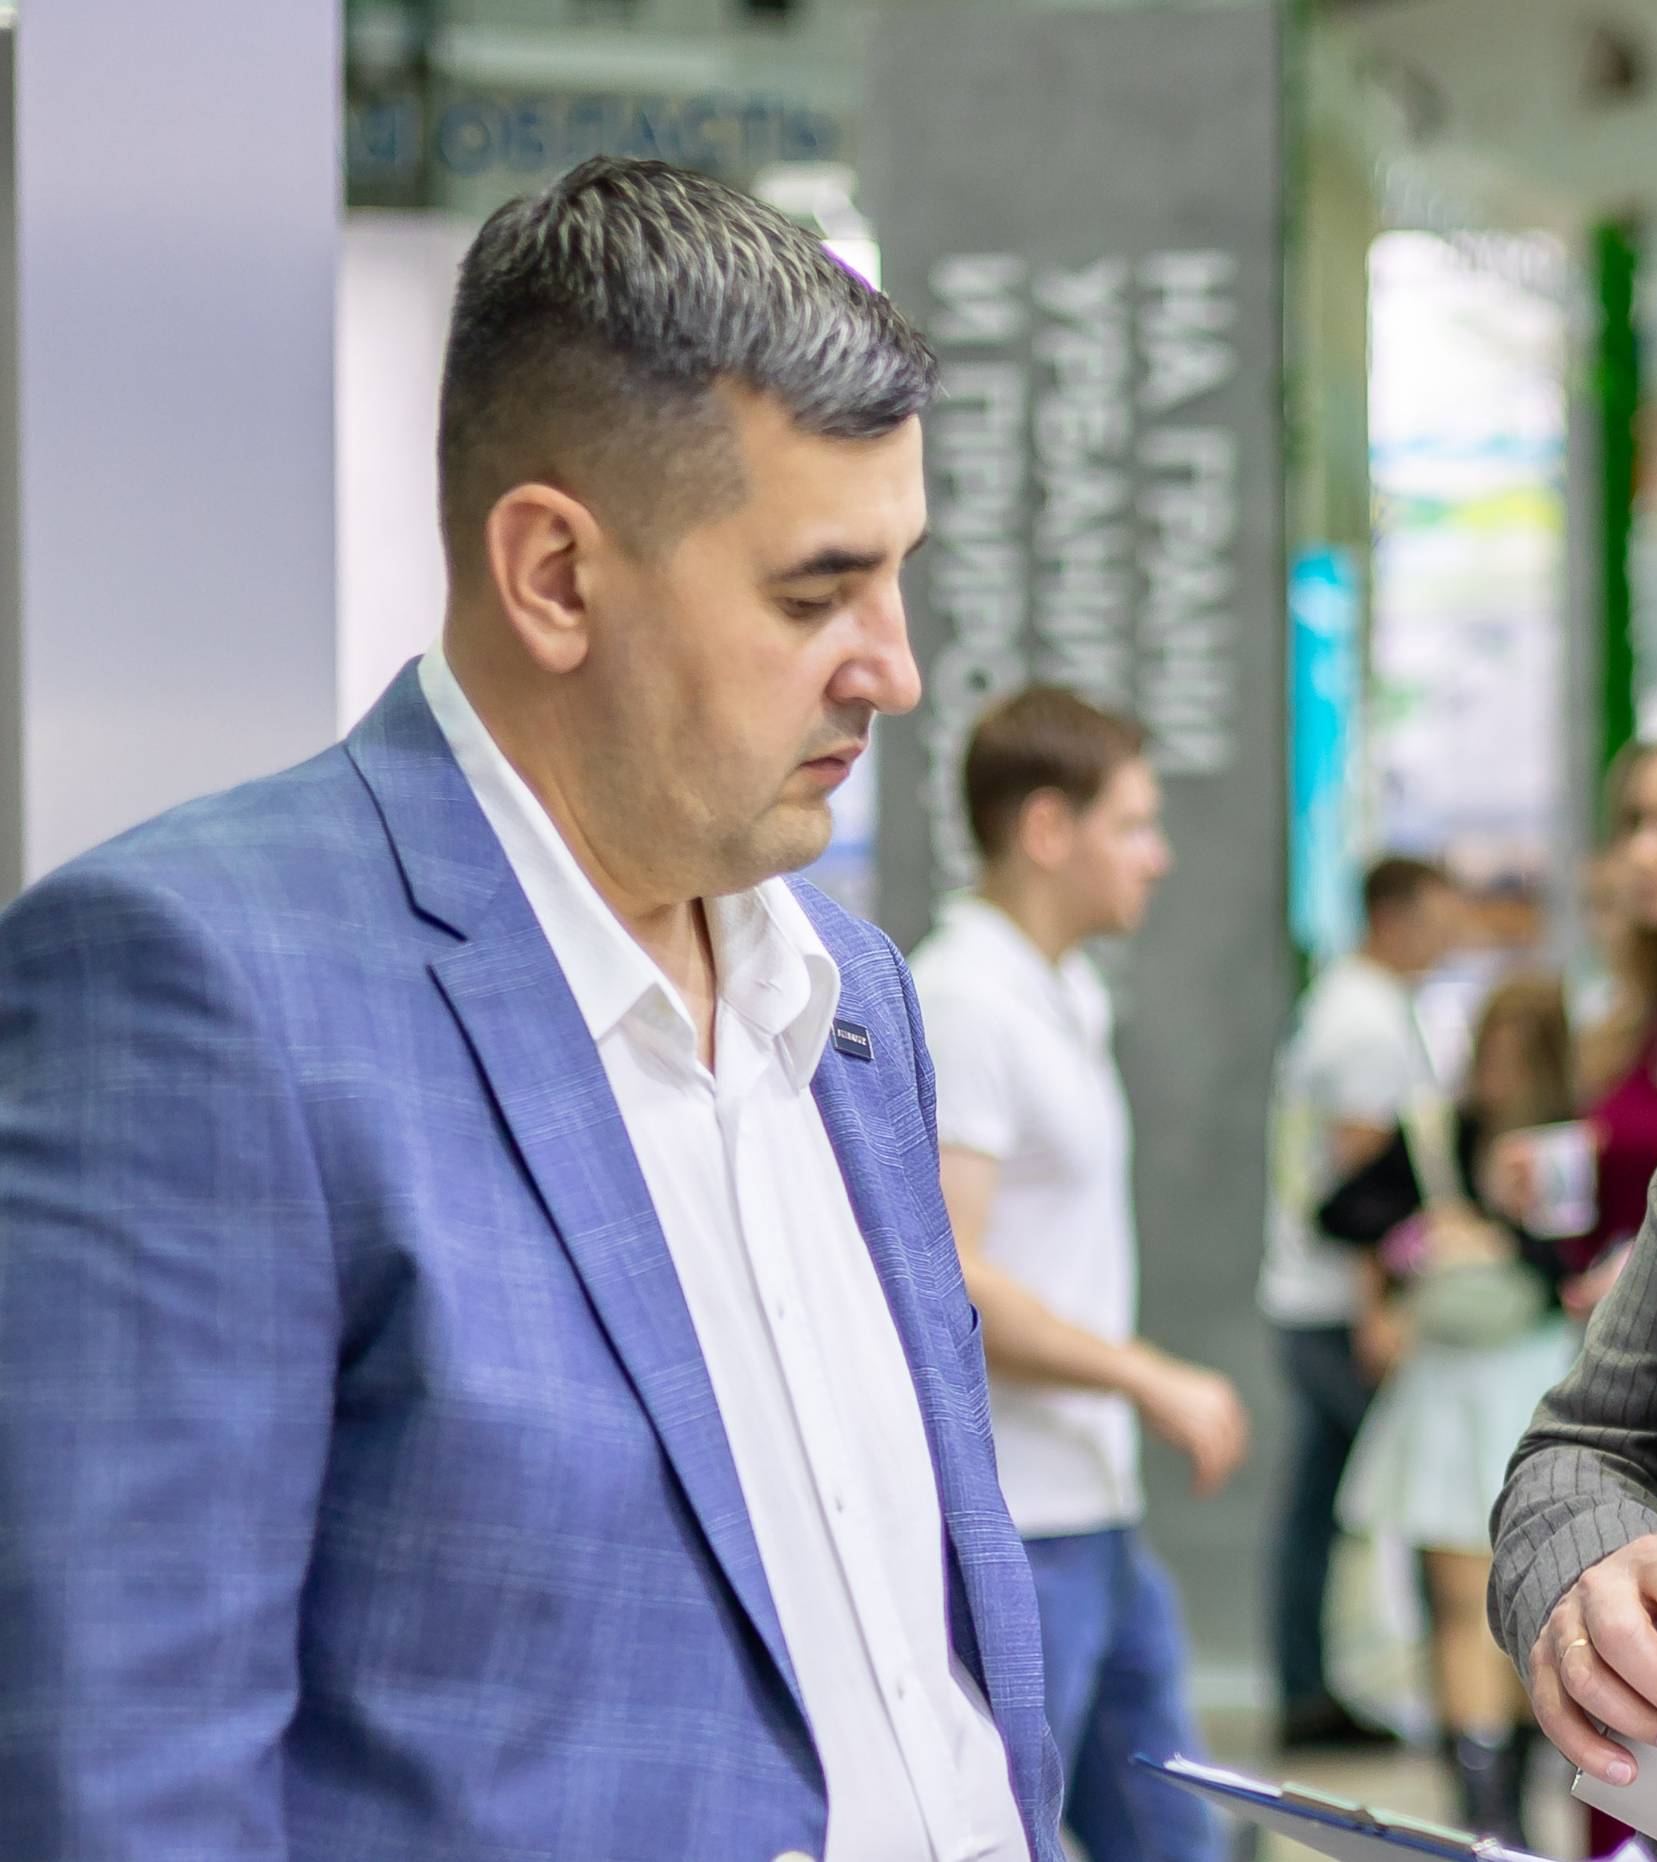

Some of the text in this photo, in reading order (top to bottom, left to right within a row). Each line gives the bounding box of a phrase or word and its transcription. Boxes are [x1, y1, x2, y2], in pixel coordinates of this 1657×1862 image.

[926, 250, 1028, 345] И
[1031, 253, 1131, 708] УРБАНИ
[1134, 247, 1238, 776] НА ГРАНИ
